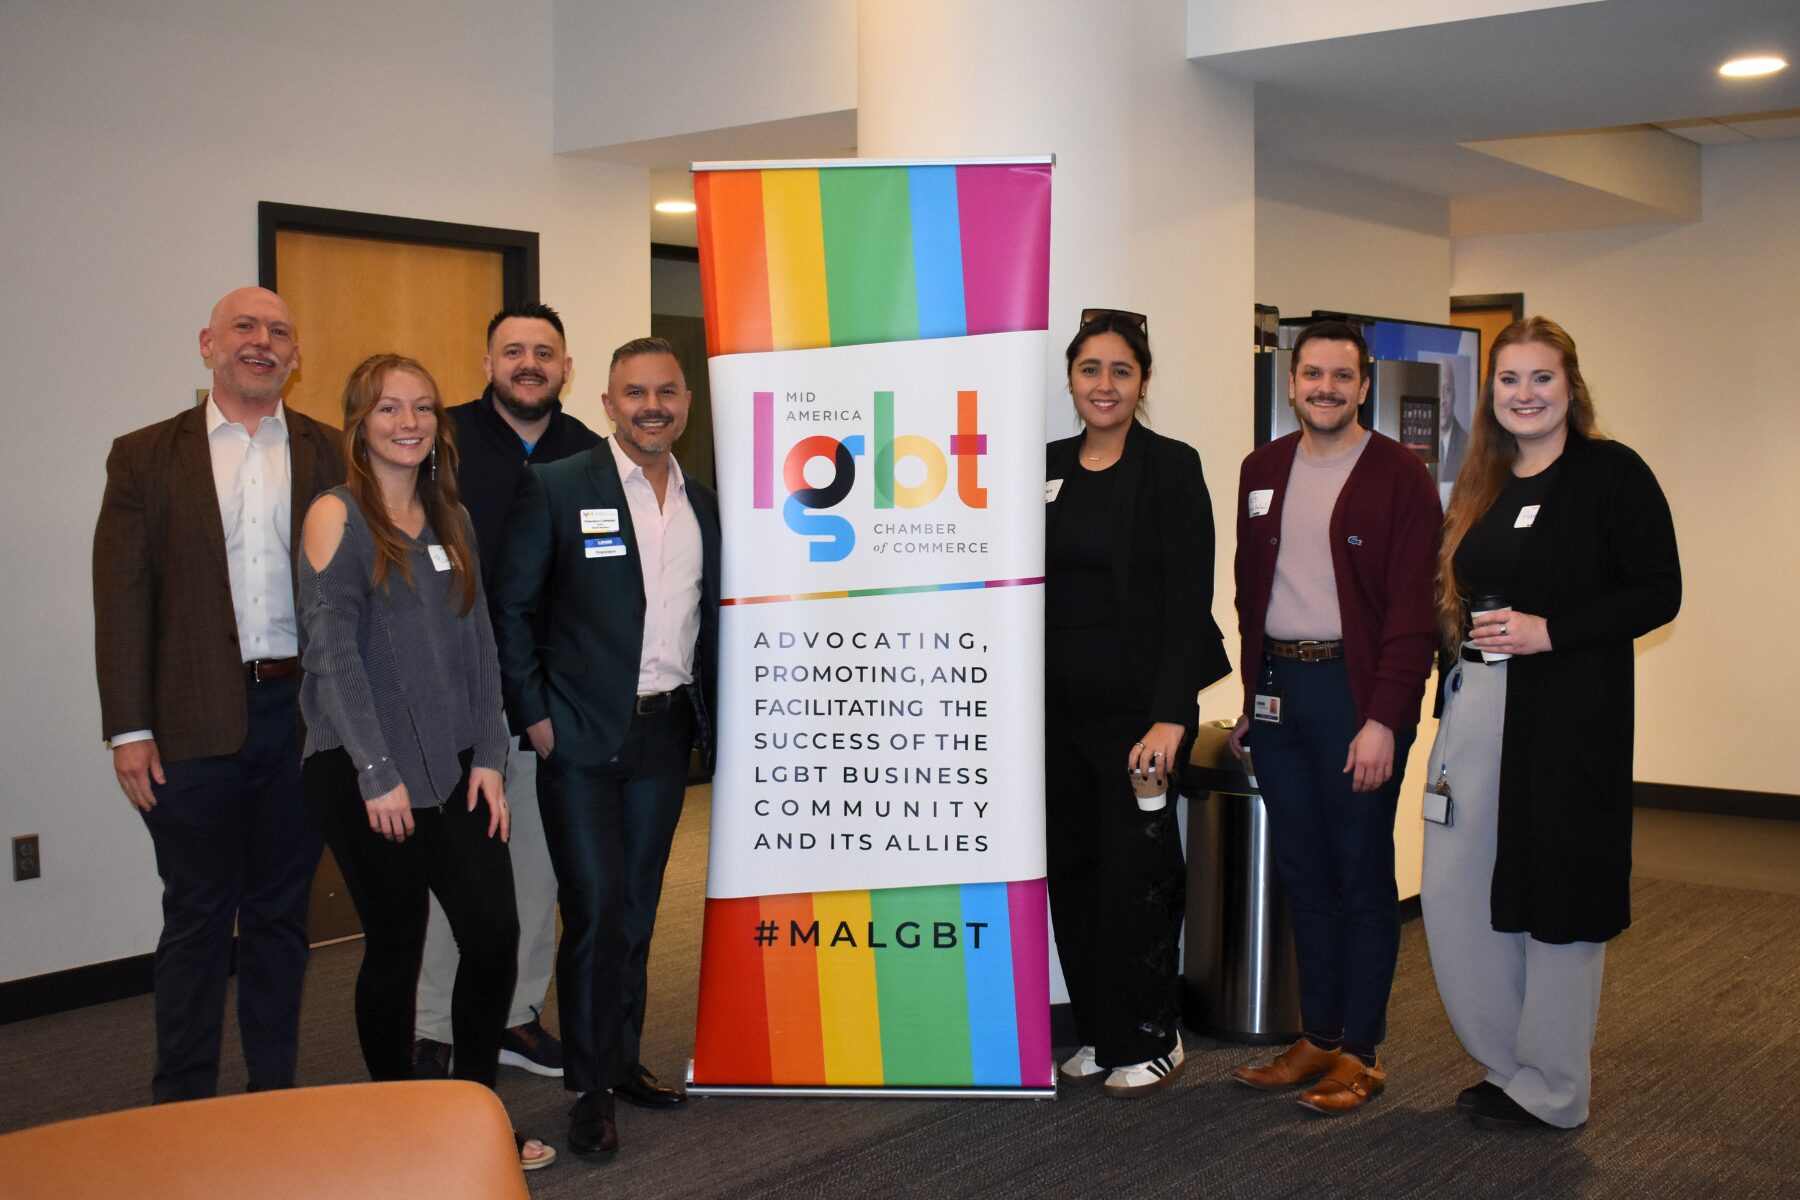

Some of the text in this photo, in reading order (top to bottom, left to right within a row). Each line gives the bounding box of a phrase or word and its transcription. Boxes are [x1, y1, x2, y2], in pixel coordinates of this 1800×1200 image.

[786, 392, 816, 403] MID
[786, 410, 862, 421] AMERICA
[874, 523, 956, 535] CHAMBER
[873, 542, 988, 554] of COMMERCE
[754, 632, 988, 653] ADVOCATING,
[755, 666, 988, 686] PROMOTING, AND
[755, 699, 988, 717] FACILITATING THE
[754, 733, 988, 751] SUCCESS OF THE
[755, 766, 988, 784] LGBT BUSINESS
[754, 800, 988, 818] COMMUNITY
[754, 833, 988, 852] AND ITS ALLIES
[753, 920, 988, 949] #MALGBT
